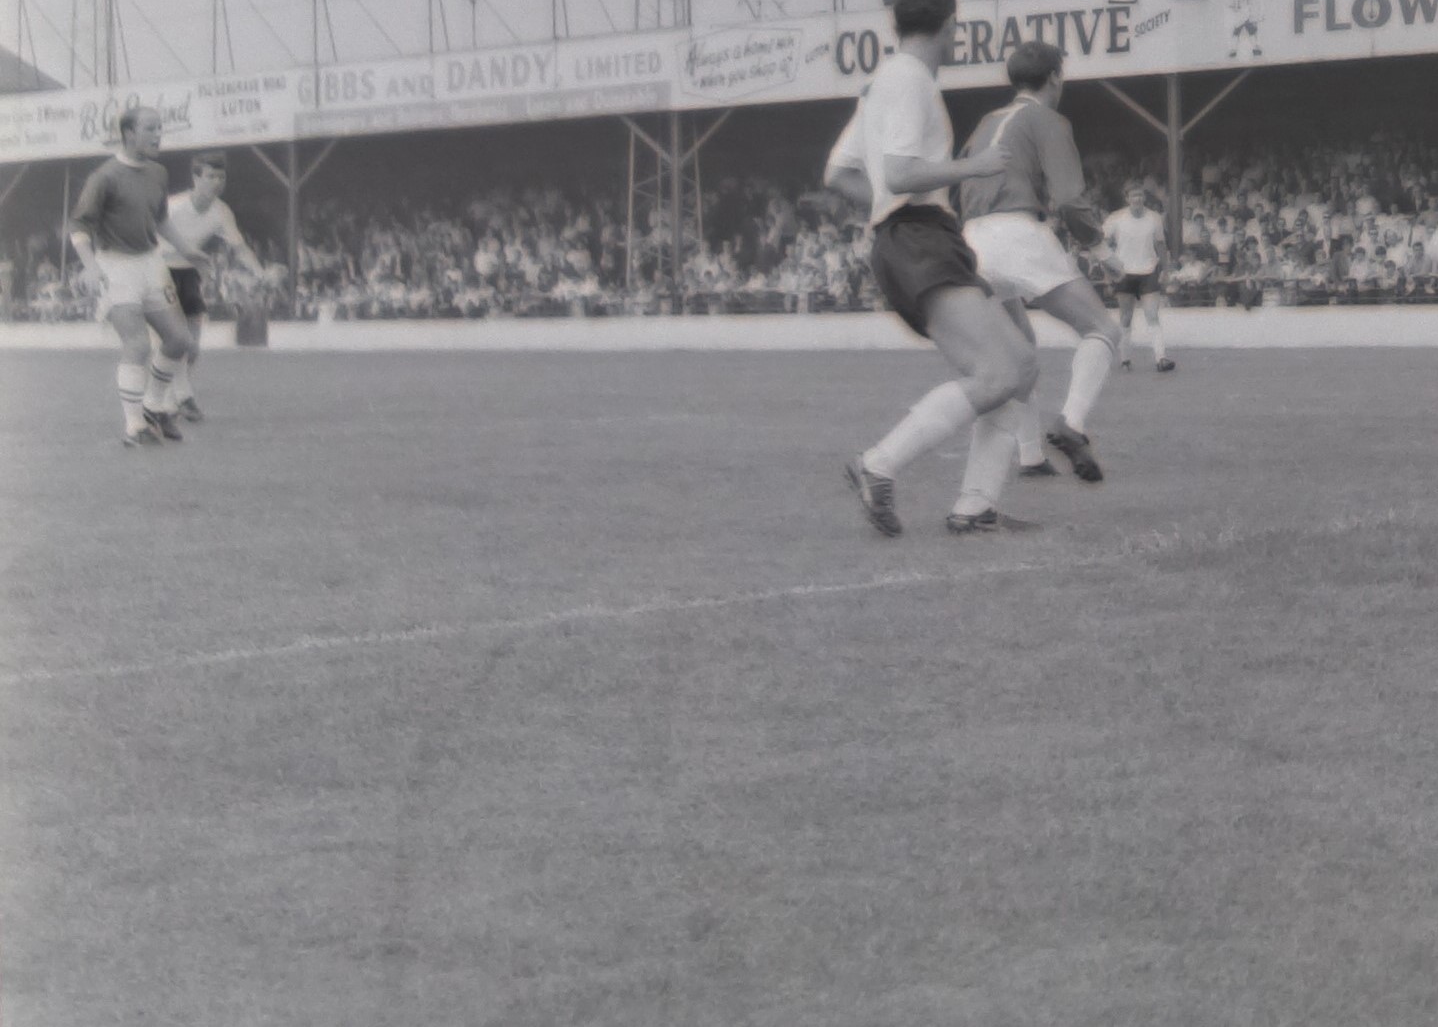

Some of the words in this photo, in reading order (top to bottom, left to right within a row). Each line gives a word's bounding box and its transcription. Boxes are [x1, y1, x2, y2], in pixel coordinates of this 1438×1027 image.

[835, 6, 1131, 75] CO-ERATIVE
[1134, 9, 1171, 38] SOCIETY
[297, 69, 376, 105] GBBS
[386, 74, 434, 100] AND
[447, 50, 553, 93] DANDY
[574, 50, 662, 82] LIMITED
[221, 99, 261, 116] LUTON
